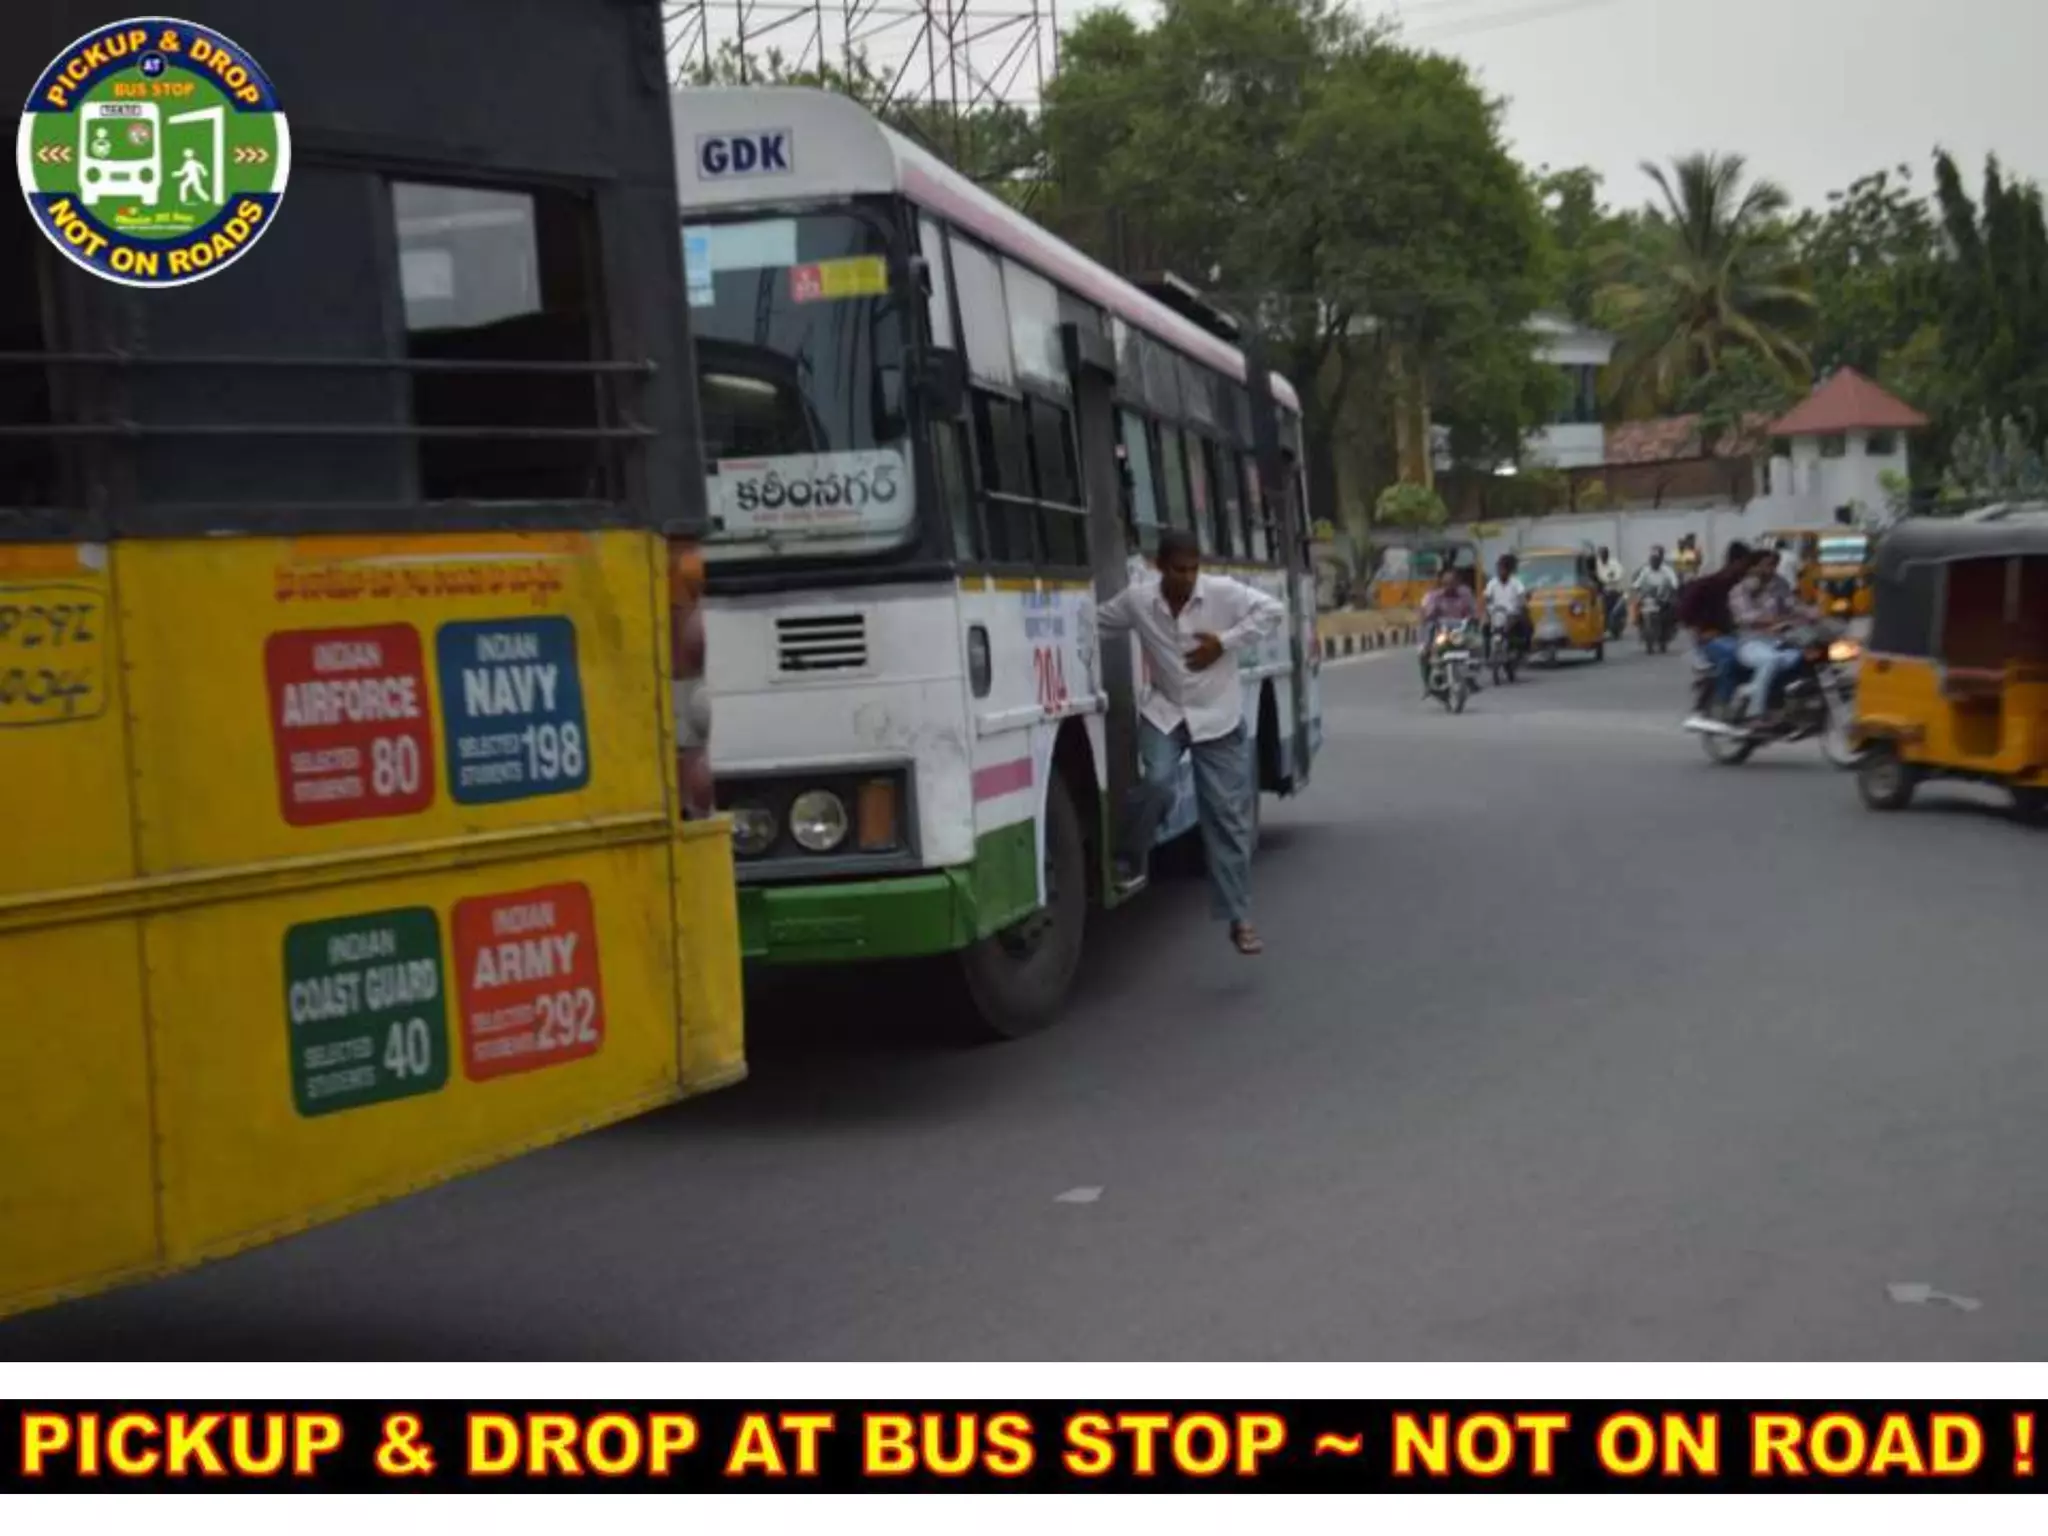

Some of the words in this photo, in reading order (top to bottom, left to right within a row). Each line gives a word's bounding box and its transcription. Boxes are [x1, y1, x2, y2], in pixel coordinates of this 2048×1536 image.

[702, 134, 787, 174] GDK
[476, 633, 539, 662] INDIAN
[282, 676, 420, 728] AIRFORCE
[462, 664, 558, 717] NAVY
[371, 735, 421, 796] 80
[522, 721, 585, 781] 198
[473, 931, 579, 990] ARMY
[290, 971, 361, 1024] COAST
[365, 958, 439, 1012] GUARD
[534, 988, 598, 1051] 292
[383, 1017, 431, 1079] 40
